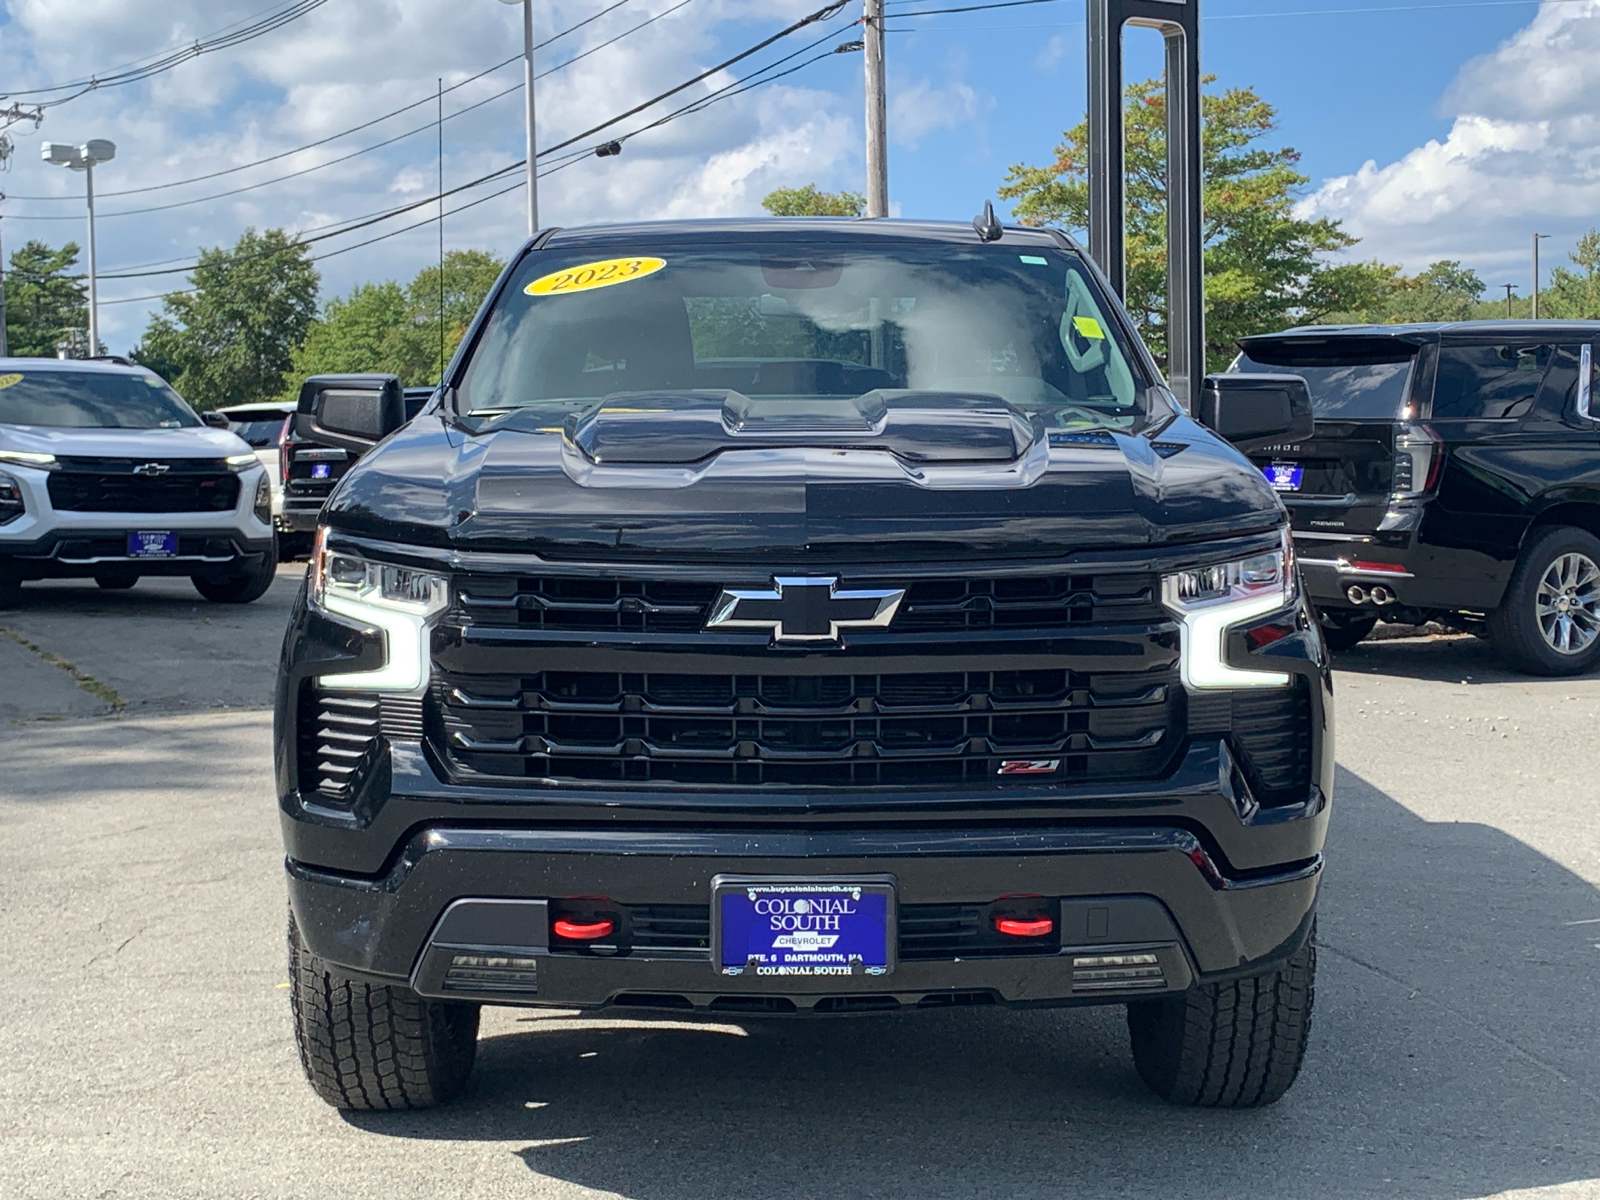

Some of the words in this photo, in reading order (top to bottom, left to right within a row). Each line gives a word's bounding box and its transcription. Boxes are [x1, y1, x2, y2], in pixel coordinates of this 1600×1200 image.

[551, 260, 642, 291] 2023
[997, 760, 1060, 775] Z71
[747, 885, 862, 894] www.buycolonialsouth.com
[754, 899, 856, 914] COLONIAL
[770, 915, 841, 930] SOUTH
[779, 937, 832, 945] CHEVROLET
[770, 954, 777, 962] 6
[784, 954, 846, 963] DARTMOUTH,
[848, 954, 863, 962] MA
[757, 966, 813, 975] COLONIAL
[814, 966, 852, 975] SOUTH
